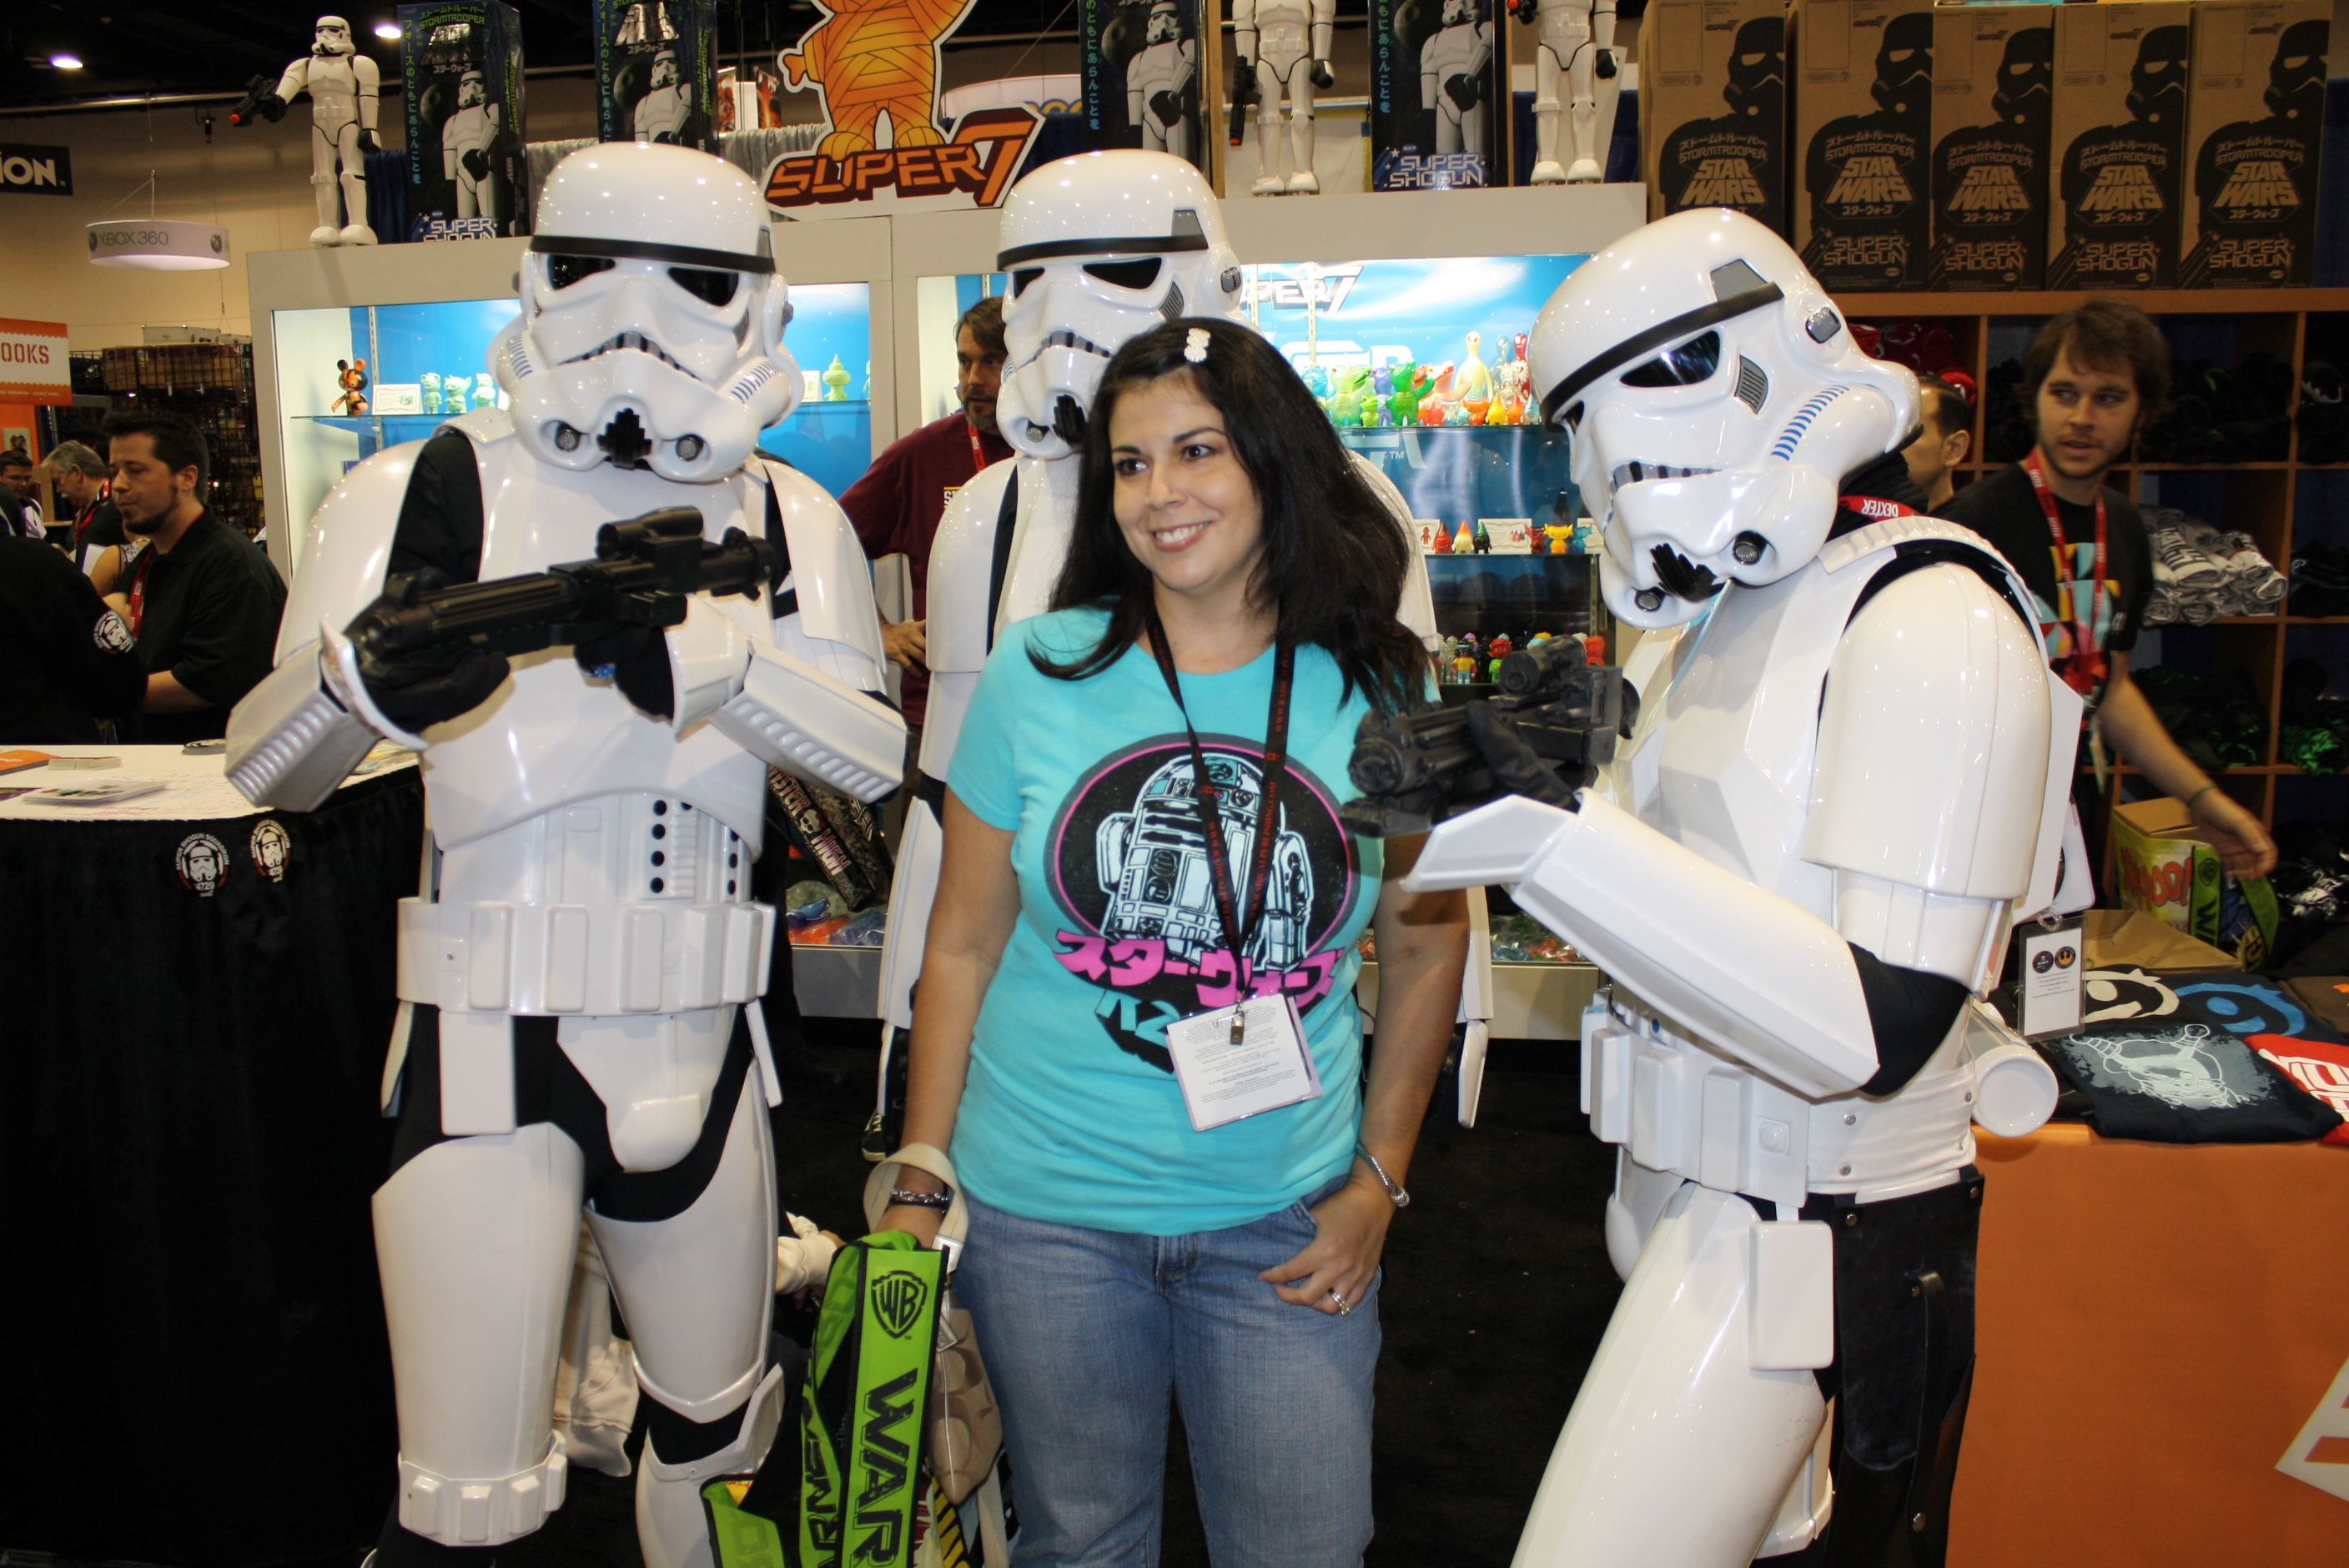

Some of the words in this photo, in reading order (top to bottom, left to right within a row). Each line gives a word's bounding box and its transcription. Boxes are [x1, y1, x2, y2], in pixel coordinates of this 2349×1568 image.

[420, 13, 485, 30] STORMTROOPER
[1378, 0, 1391, 113] もにあらんことを
[765, 117, 1039, 206] SUPER7
[1680, 145, 1767, 163] STORMTROOPER
[1826, 143, 1915, 161] STORMTROOPER
[1948, 153, 2033, 168] STORMTROOPER
[2080, 153, 2165, 168] STORMTROOPER
[2216, 148, 2303, 165] STORMTROOPER
[1401, 153, 1480, 171] SUPER
[1694, 158, 1753, 179] STAR
[1840, 156, 1901, 178] STAR
[2229, 161, 2289, 182] STAR
[1390, 169, 1482, 188] SHOGUN
[1961, 166, 2020, 186] STAR
[2095, 166, 2154, 186] STAR
[1679, 178, 1766, 206] WARS
[1825, 176, 1913, 204] WARS
[1947, 185, 2030, 211] WARS
[2080, 185, 2164, 211] WARS
[2214, 181, 2300, 207] WARS
[430, 218, 495, 234] SUPER
[98, 231, 136, 246] XBOX
[138, 230, 168, 246] 360
[1834, 236, 1905, 252] SUPER
[2219, 240, 2290, 254] SUPER
[1823, 251, 1906, 266] SHOGUN
[1954, 242, 2022, 257] SUPER
[2086, 243, 2155, 257] SUPER
[1945, 256, 2023, 270] SHOGUN
[2076, 257, 2156, 271] SHOGUN
[2209, 253, 2292, 268] SHOGUN
[1240, 265, 1364, 316] PER7
[1, 342, 49, 364] OOKS
[1390, 451, 1405, 460] TM
[1861, 499, 1899, 518] DEXTER
[768, 764, 812, 817] NSTER
[810, 828, 852, 876] HIGH
[1249, 781, 1278, 919] W.RADICALPUBLISHING.COM
[875, 1275, 923, 1332] WB
[849, 1368, 918, 1568] WAR
